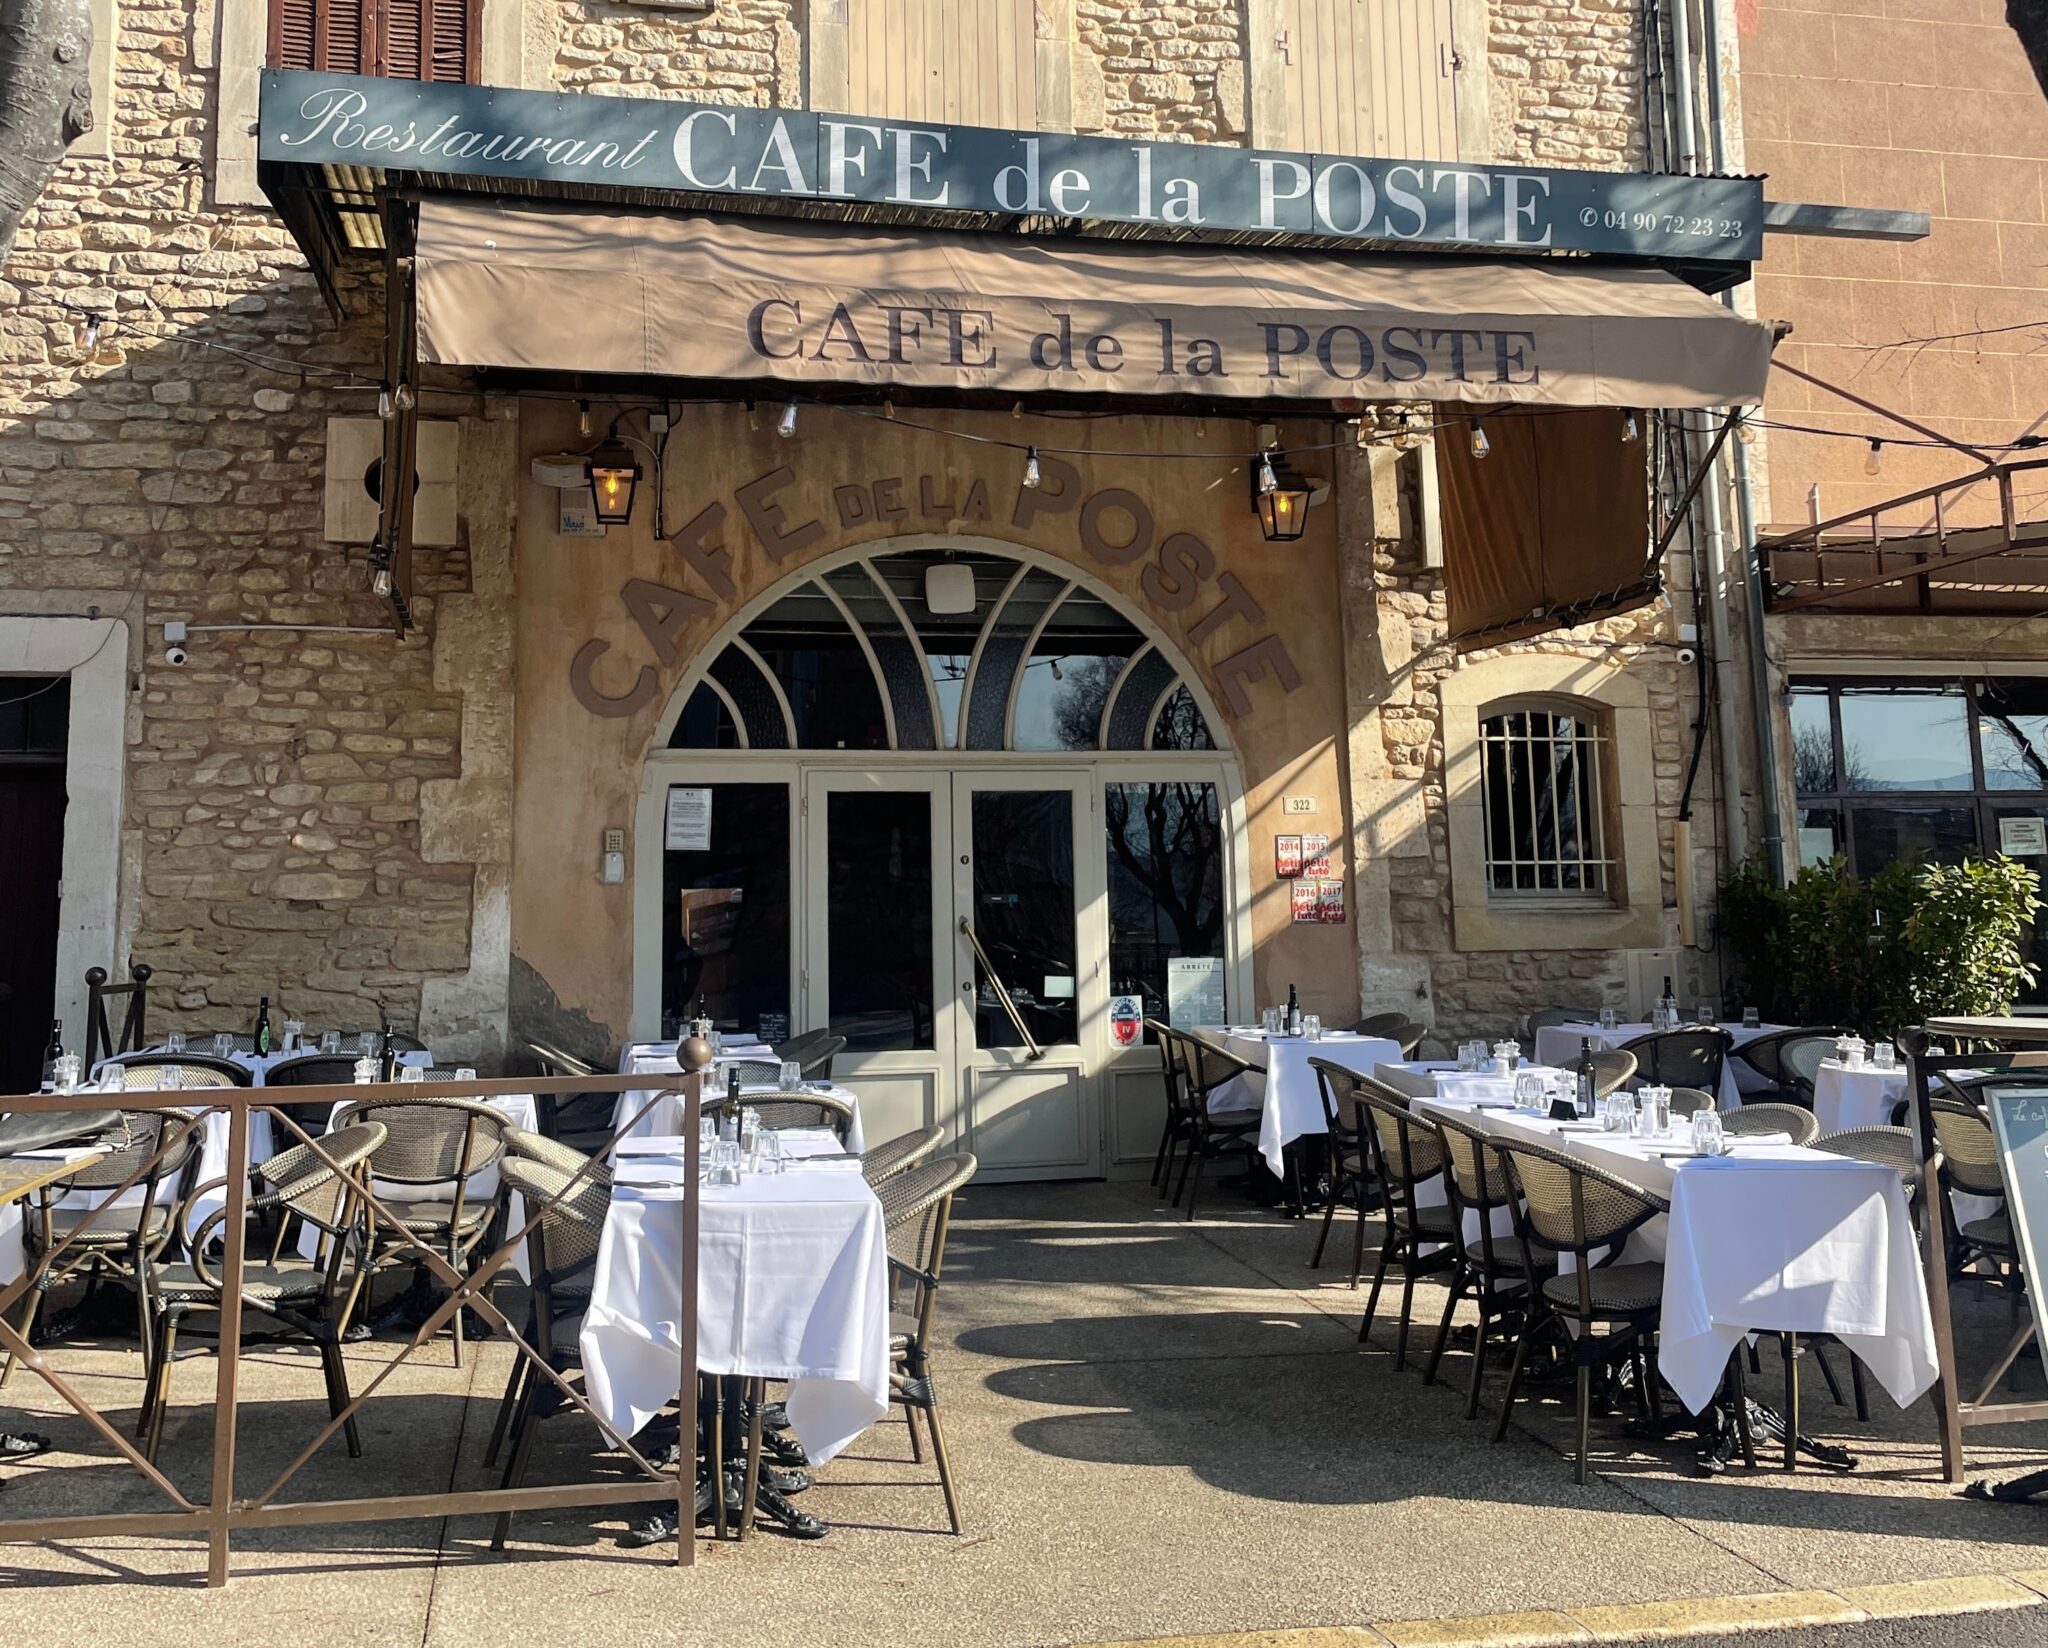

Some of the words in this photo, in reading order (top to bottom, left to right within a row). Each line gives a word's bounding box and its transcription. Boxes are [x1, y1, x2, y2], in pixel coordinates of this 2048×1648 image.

[280, 88, 662, 171] Restaurant
[671, 109, 950, 206] CAFE
[992, 137, 1092, 214] de
[1130, 146, 1206, 226] la
[1248, 158, 1553, 247] POSTE
[1604, 210, 1628, 230] 04
[1633, 213, 1657, 232] 90
[1663, 214, 1685, 234] 72
[1690, 217, 1713, 237] 23
[1719, 219, 1743, 239] 23
[746, 298, 997, 371] CAFE
[1029, 314, 1125, 376] de
[1156, 318, 1231, 379] la
[1256, 321, 1541, 386] POSTE
[570, 464, 827, 719] CAFE
[833, 475, 910, 530] DE
[920, 474, 993, 522] LA
[1012, 455, 1303, 720] POSTE
[1293, 799, 1310, 811] 322
[1279, 842, 1299, 851] 2014
[1306, 842, 1325, 851] 2015
[1295, 888, 1316, 897] 2016
[1322, 887, 1341, 896] 2017
[1122, 1025, 1131, 1034] IV
